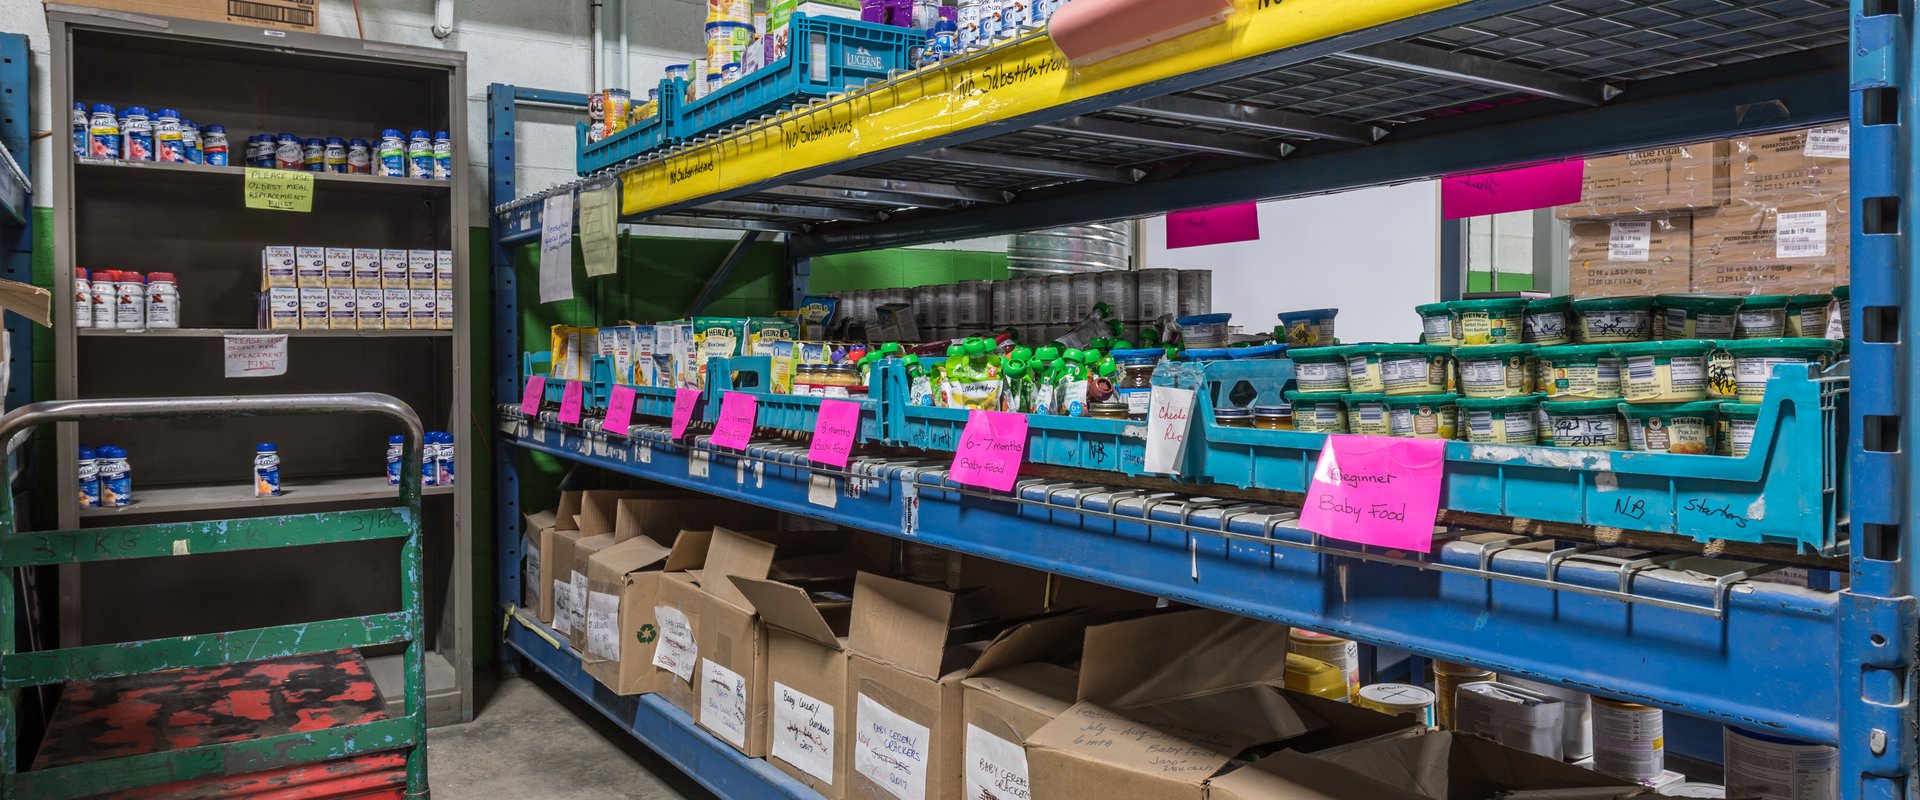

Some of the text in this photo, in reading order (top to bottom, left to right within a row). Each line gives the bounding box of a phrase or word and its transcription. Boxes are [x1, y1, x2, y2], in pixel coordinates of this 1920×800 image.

[847, 53, 882, 69] LUCERNE
[958, 57, 1068, 101] No Substitution
[800, 120, 853, 144] Substitutions
[1630, 157, 1664, 167] Company
[676, 160, 714, 182] Substitutions
[248, 182, 281, 190] OLDEST
[249, 192, 306, 200] REPLACEMENT
[763, 329, 779, 337] HEINZ
[228, 352, 283, 360] REPLACEMENT
[247, 360, 276, 368] FIRST
[733, 431, 746, 440] Food
[821, 422, 850, 437] 8 months
[814, 439, 848, 458] Baby Food
[994, 440, 1022, 451] months
[961, 458, 1005, 477] Baby Food
[1331, 467, 1397, 488] Beginner
[1319, 494, 1406, 523] Baby Food
[1615, 496, 1645, 520] NB
[32, 534, 77, 560] 37
[784, 690, 795, 709] Baby
[873, 723, 887, 734] BABY
[884, 740, 920, 762] CRACKERS
[1146, 745, 1219, 758] Baby Food
[980, 758, 998, 777] BABY
